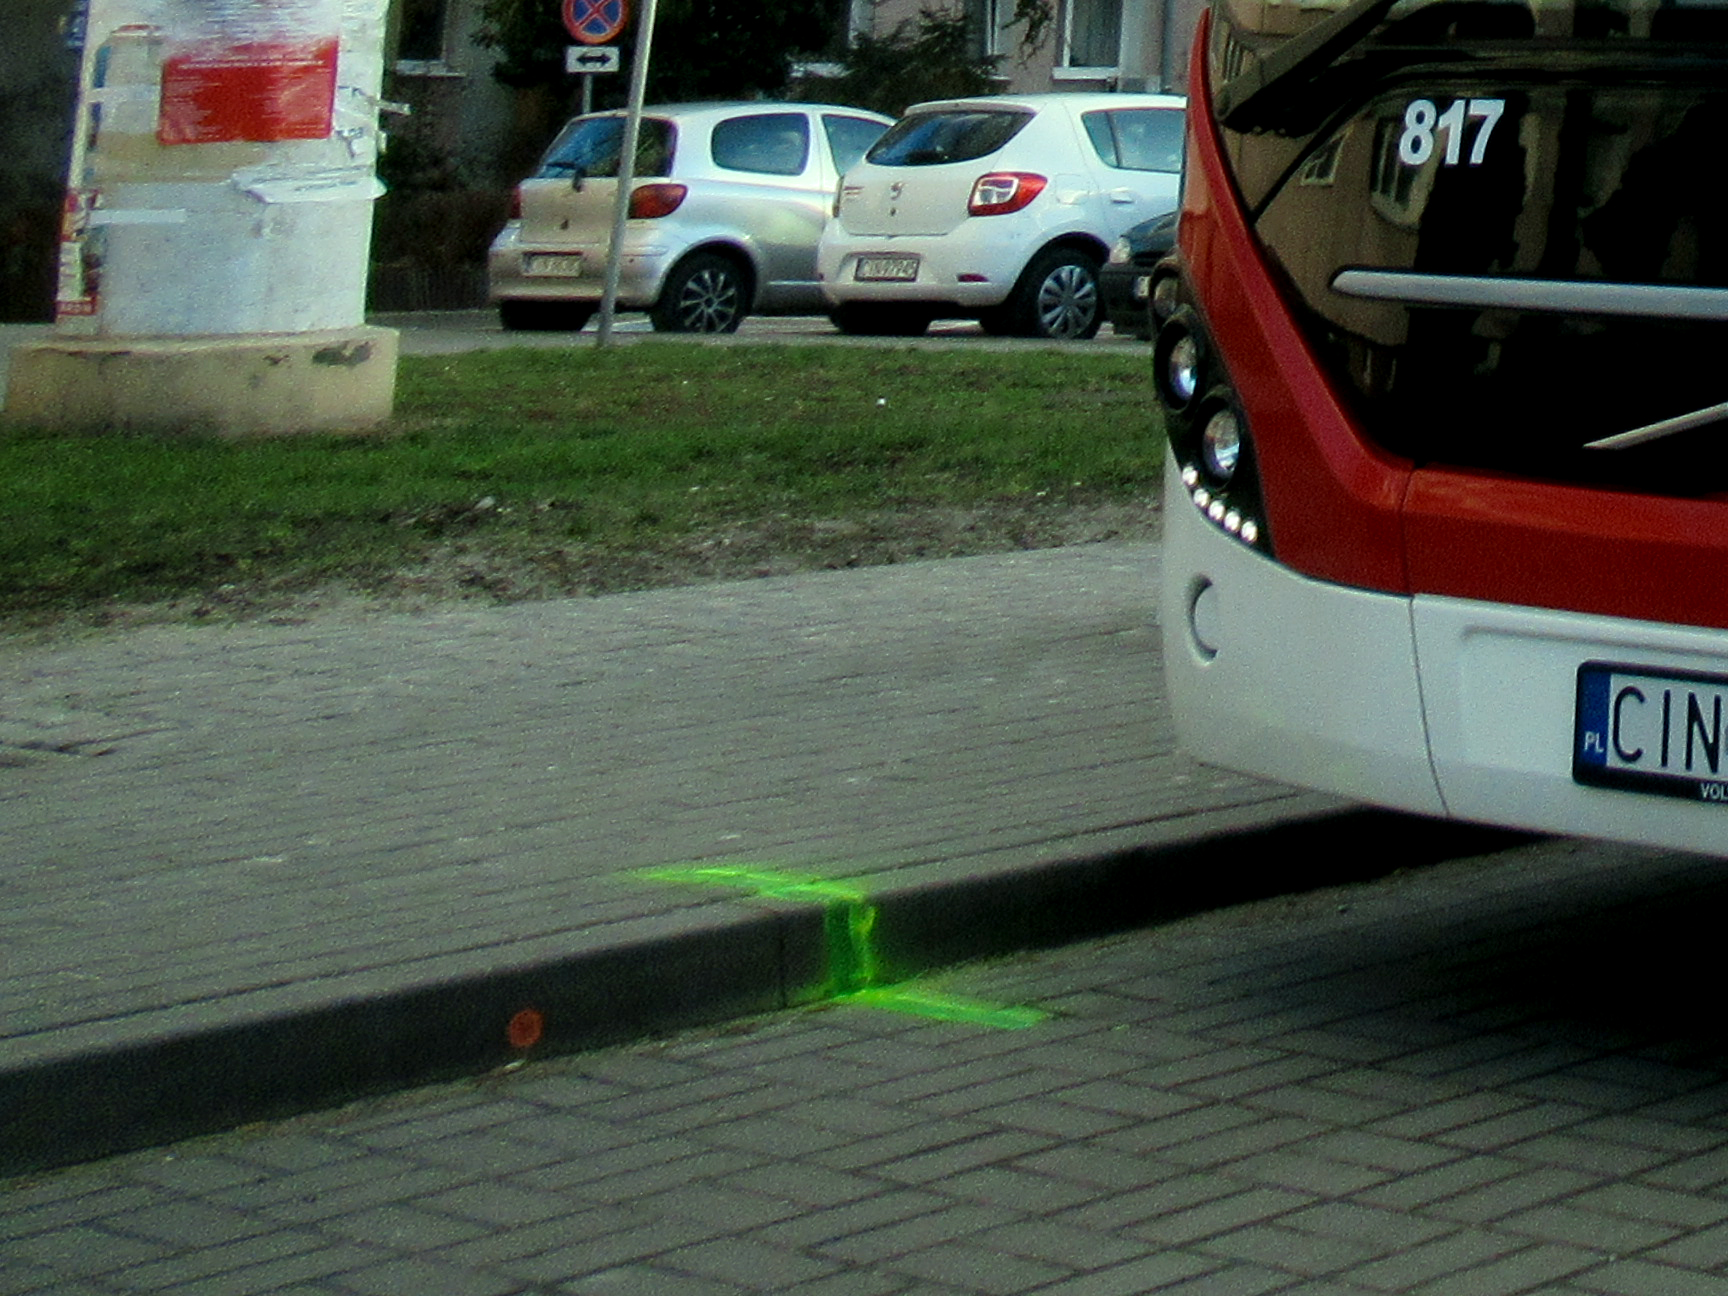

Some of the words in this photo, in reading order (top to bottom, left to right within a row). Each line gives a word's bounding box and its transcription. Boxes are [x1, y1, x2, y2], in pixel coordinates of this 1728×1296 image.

[1399, 98, 1506, 166] 817
[1583, 730, 1604, 754] PL
[1611, 685, 1722, 775] CIN
